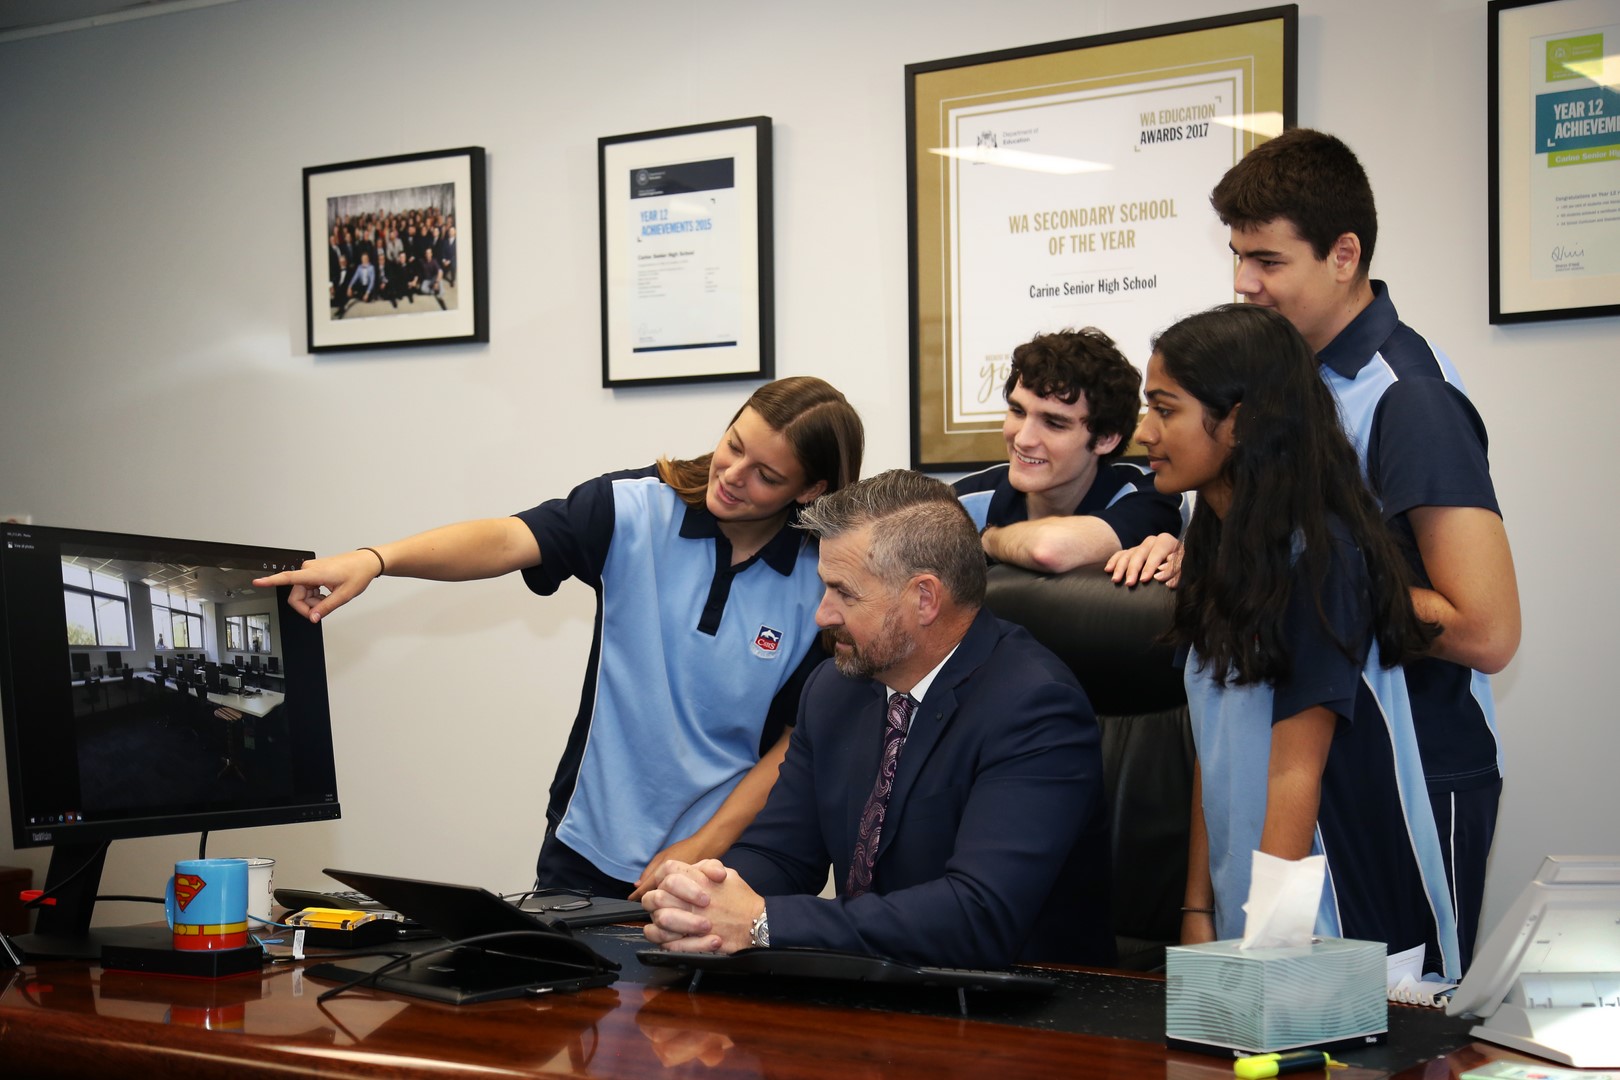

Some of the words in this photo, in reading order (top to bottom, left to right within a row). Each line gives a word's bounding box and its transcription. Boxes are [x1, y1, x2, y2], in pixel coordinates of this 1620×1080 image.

[1140, 111, 1156, 127] WA
[1158, 103, 1216, 125] EDUCATION
[1553, 101, 1585, 121] YEAR
[1588, 98, 1604, 116] 12
[1003, 137, 1031, 146] Education
[1140, 126, 1184, 145] AWARDS
[1186, 122, 1209, 139] 2017
[1555, 154, 1580, 163] Carine
[1582, 151, 1607, 160] Senior
[641, 209, 657, 222] YEAR
[660, 208, 668, 221] 12
[641, 220, 694, 236] ACHIEVEMENTS
[695, 217, 712, 231] 2015
[1009, 214, 1029, 234] WA
[1034, 205, 1116, 232] SECONDARY
[1120, 198, 1178, 223] SCHOOL
[1049, 236, 1066, 256] OF
[1070, 233, 1096, 254] THE
[1101, 229, 1136, 251] YEAR
[1029, 284, 1060, 299] Carine
[1063, 281, 1095, 296] Senior
[1098, 277, 1120, 295] High
[1123, 274, 1157, 291] School
